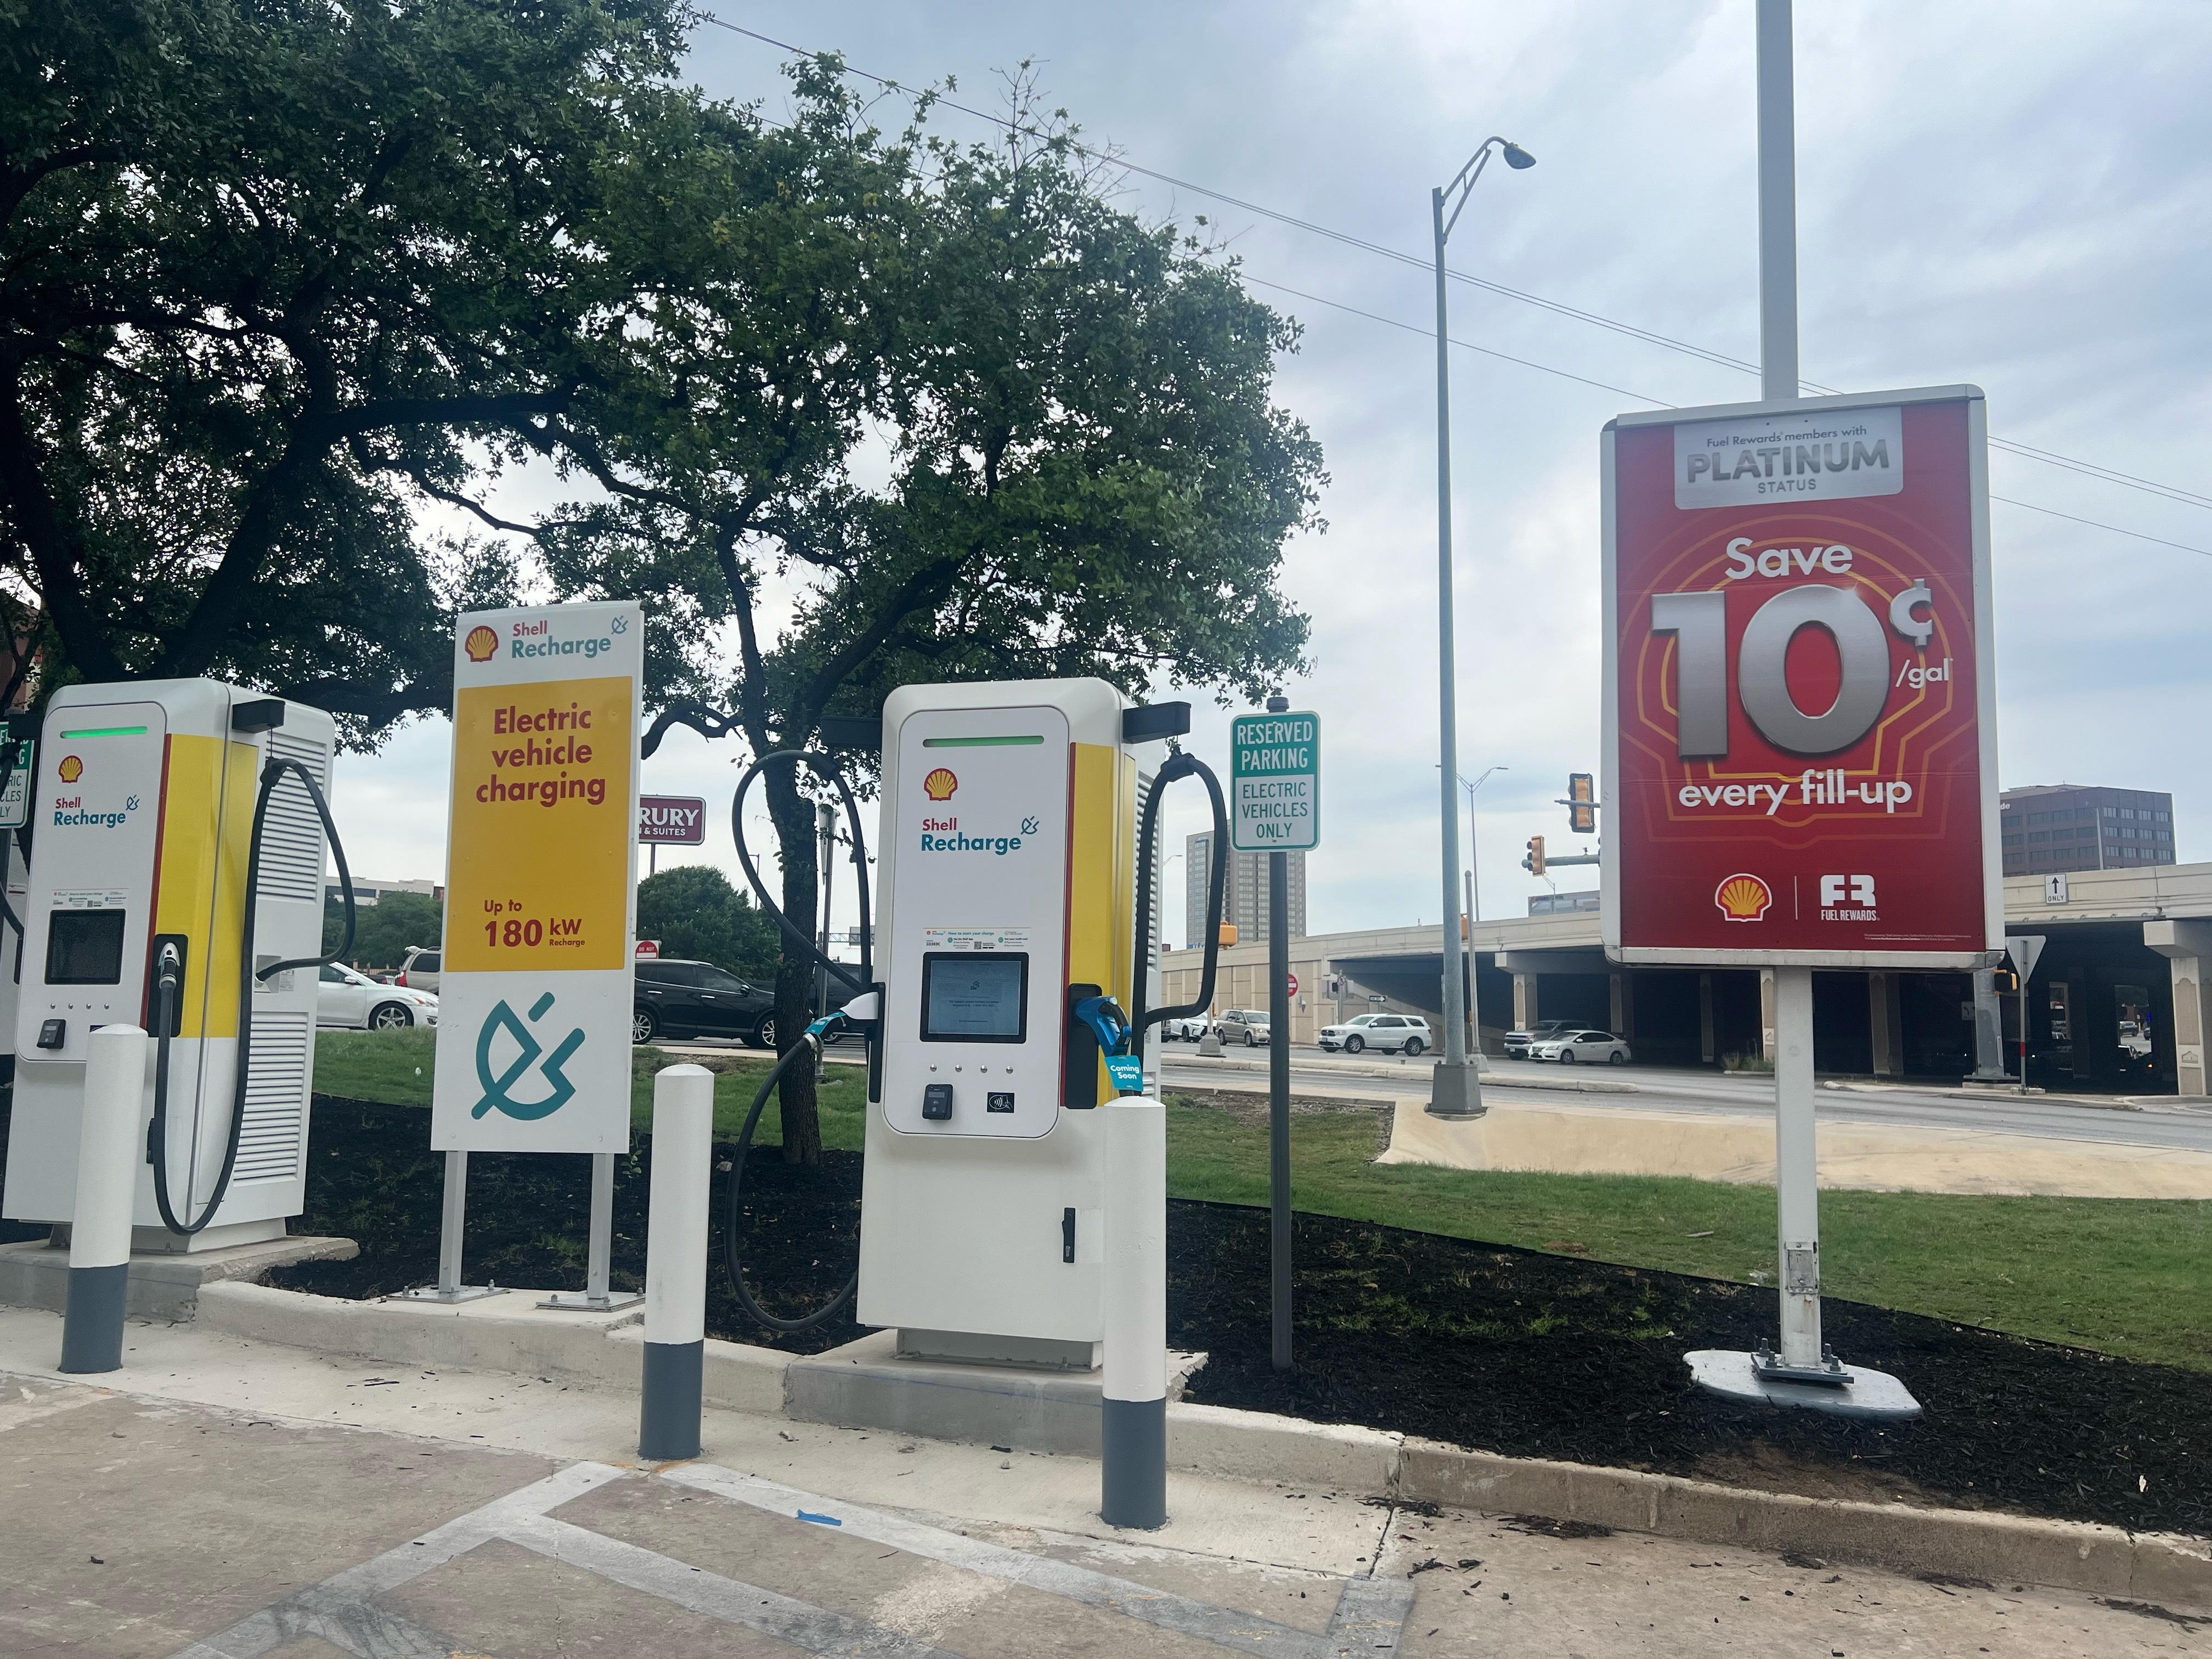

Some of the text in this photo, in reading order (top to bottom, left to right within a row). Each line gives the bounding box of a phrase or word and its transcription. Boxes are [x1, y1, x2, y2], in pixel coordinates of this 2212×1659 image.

[1707, 436, 1729, 447] Fuel
[1785, 429, 1837, 441] members
[1841, 426, 1866, 437] with
[1687, 439, 1889, 483] PLATINUM
[1758, 478, 1816, 494] STATUS
[1725, 537, 1853, 579] Save
[512, 620, 548, 637] Shell
[512, 635, 611, 658] Recharge
[494, 702, 591, 734] Electric
[1237, 721, 1313, 745] RESERVED
[492, 736, 592, 768] vehicle
[1242, 747, 1308, 771] PARKING
[476, 771, 606, 808] charging
[1243, 782, 1307, 799] ELECTRIC
[1679, 769, 1912, 815] every fill-up
[55, 797, 81, 809] Shell
[1242, 802, 1308, 819] VEHICLES
[54, 809, 126, 828] Recharge
[640, 807, 699, 826] RURY
[922, 817, 957, 831] Shell
[1256, 823, 1292, 838] ONLY
[921, 832, 1022, 855] Recharge
[484, 899, 522, 916] Up to
[1821, 910, 1876, 921] FUEL REWARDS
[484, 918, 582, 947] 180 kW
[549, 938, 585, 947] Recharge
[1110, 1064, 1139, 1074] Coming
